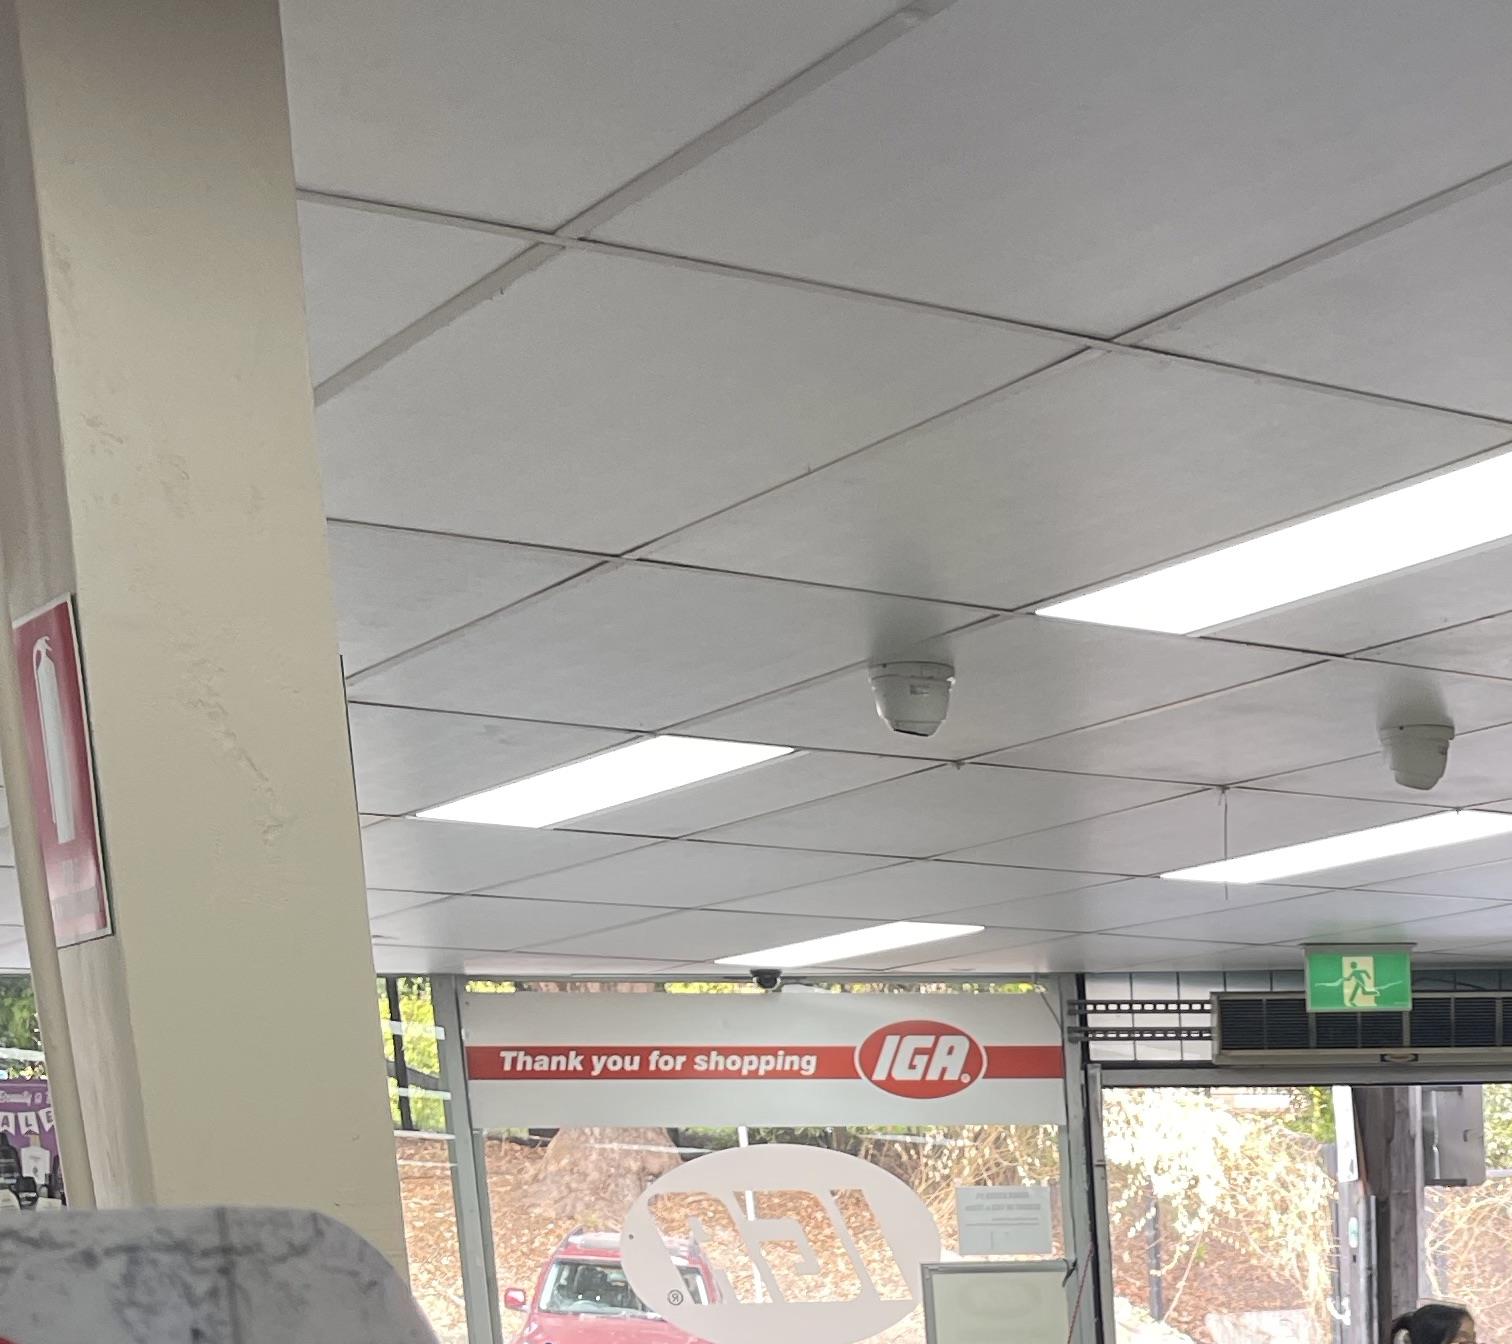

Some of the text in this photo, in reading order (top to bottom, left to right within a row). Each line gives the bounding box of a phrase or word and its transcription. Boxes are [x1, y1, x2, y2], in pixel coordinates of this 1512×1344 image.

[500, 1050, 582, 1071] Thank
[591, 1054, 640, 1076] you
[649, 1051, 686, 1071] for
[694, 1051, 818, 1076] shopping
